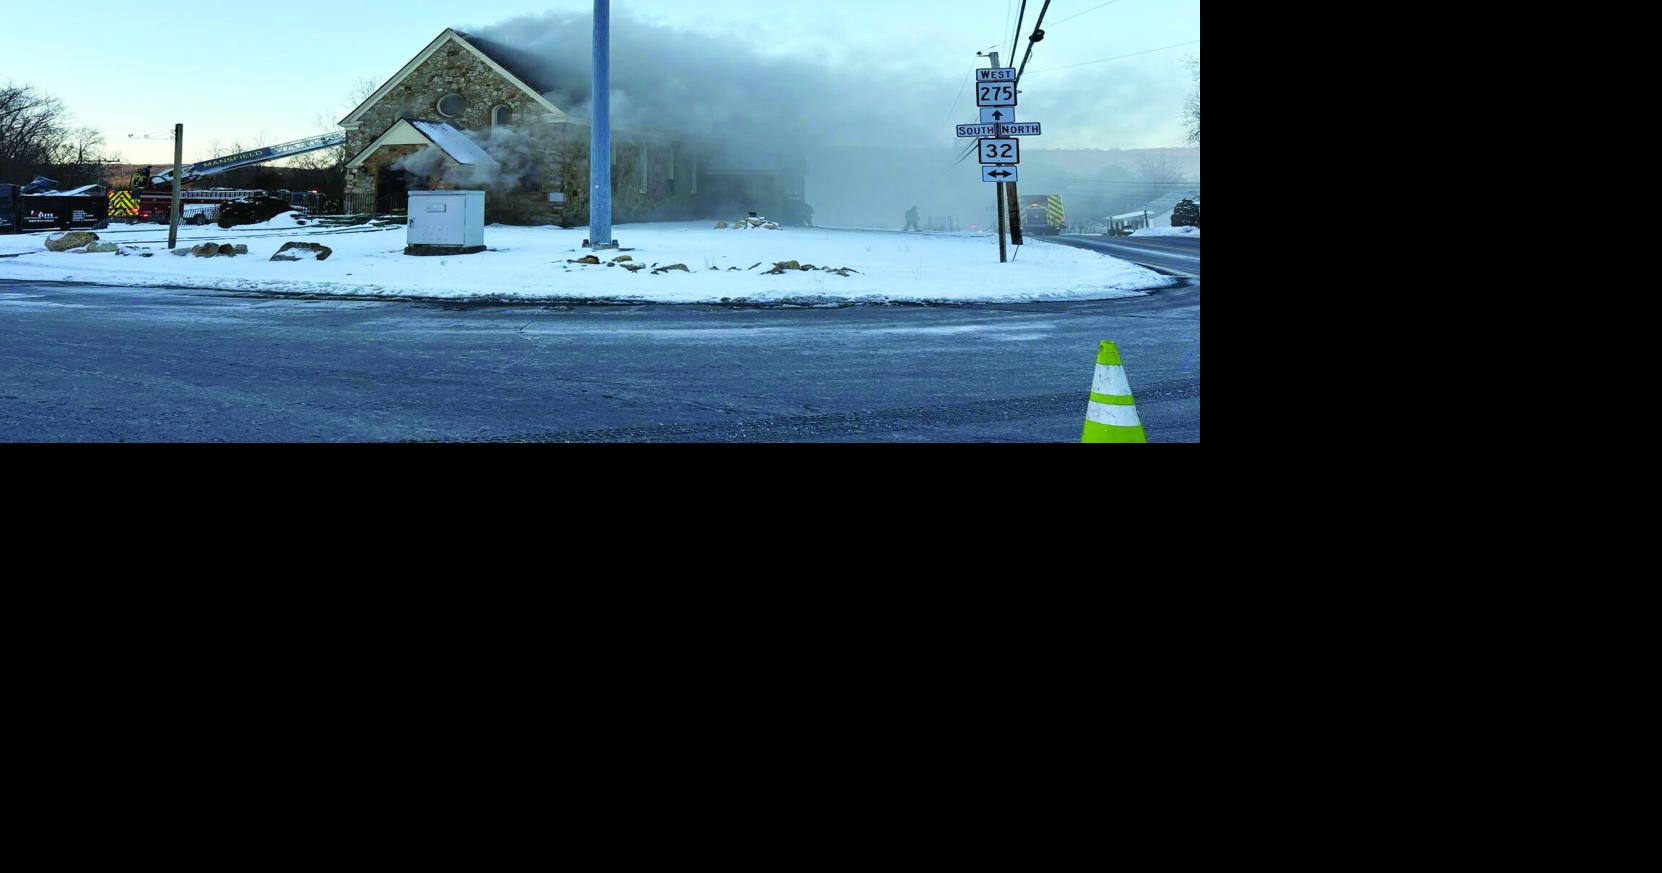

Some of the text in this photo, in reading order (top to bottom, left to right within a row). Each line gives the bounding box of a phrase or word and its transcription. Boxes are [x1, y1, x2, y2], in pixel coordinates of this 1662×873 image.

[980, 70, 1011, 79] WEST
[980, 86, 1013, 101] 275
[958, 126, 994, 135] SOUTH
[1002, 125, 1039, 134] NORTH
[986, 144, 1013, 158] 32
[203, 150, 263, 168] MANSFIELD
